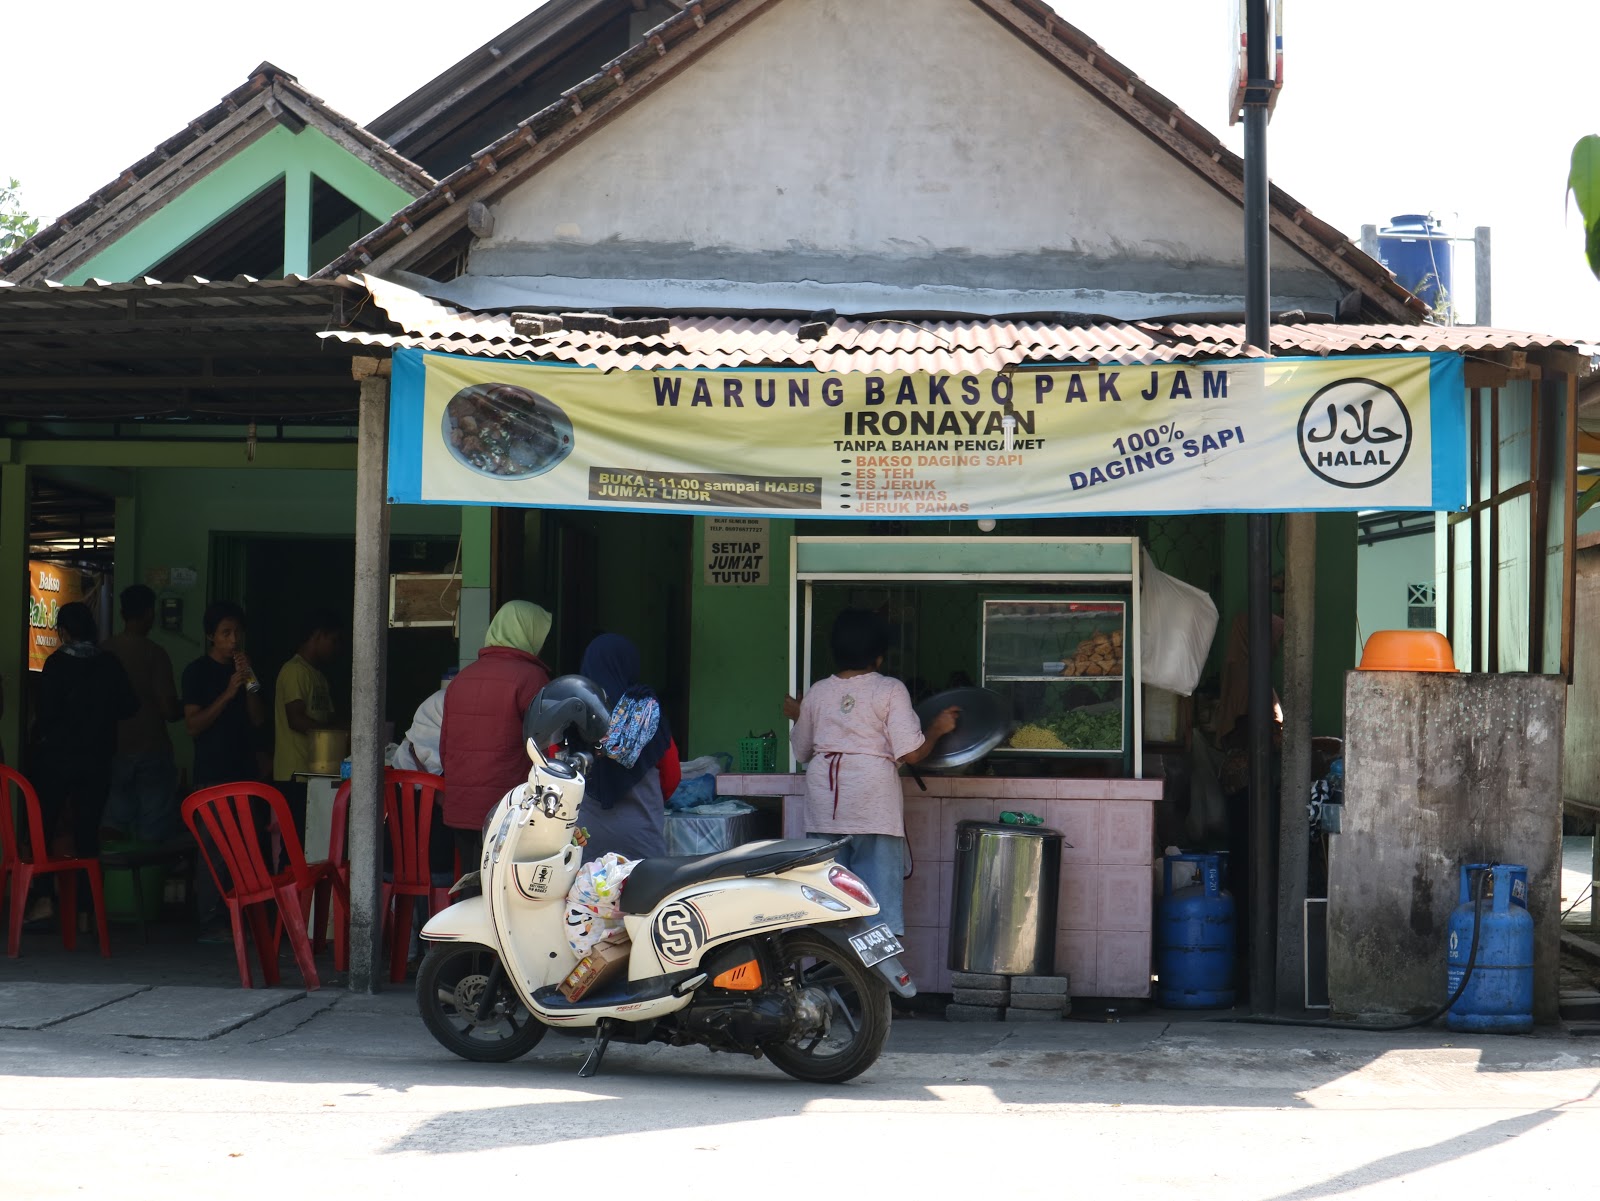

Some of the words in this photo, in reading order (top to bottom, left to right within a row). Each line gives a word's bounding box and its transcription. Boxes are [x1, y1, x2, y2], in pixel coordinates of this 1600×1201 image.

[653, 376, 844, 408] WARUNG
[865, 374, 1014, 406] BAKSO
[1035, 372, 1122, 404] PAK
[1141, 370, 1228, 401] JAM
[844, 410, 1036, 436] IRONAYAN
[1307, 399, 1403, 445] حلال
[1112, 421, 1185, 456] 100%
[833, 440, 885, 452] TANPA
[891, 440, 949, 452] BAHAN
[856, 455, 912, 467] BAKSO
[917, 455, 981, 467] DAGING
[986, 454, 1023, 466] SAPI
[1069, 446, 1175, 491] DAGING
[1182, 426, 1245, 458] SAPI
[1318, 449, 1391, 467] HALAL
[856, 468, 877, 479] ES
[881, 468, 914, 479] TEH
[598, 473, 645, 487] BUKA
[658, 477, 700, 490] 11.00
[704, 481, 760, 494] sampai
[764, 481, 816, 493] HABIS
[855, 480, 876, 490] ES
[881, 480, 936, 490] JERUK
[662, 489, 711, 502] LIBUR
[855, 491, 888, 501] TEH
[893, 490, 947, 501] PANAS
[855, 502, 910, 513] JERUK
[915, 502, 970, 513] PANAS
[711, 542, 761, 554] SETIAP
[708, 555, 764, 570] JUM'AT
[38, 571, 60, 592] Bakso
[711, 571, 761, 583] TUTUP
